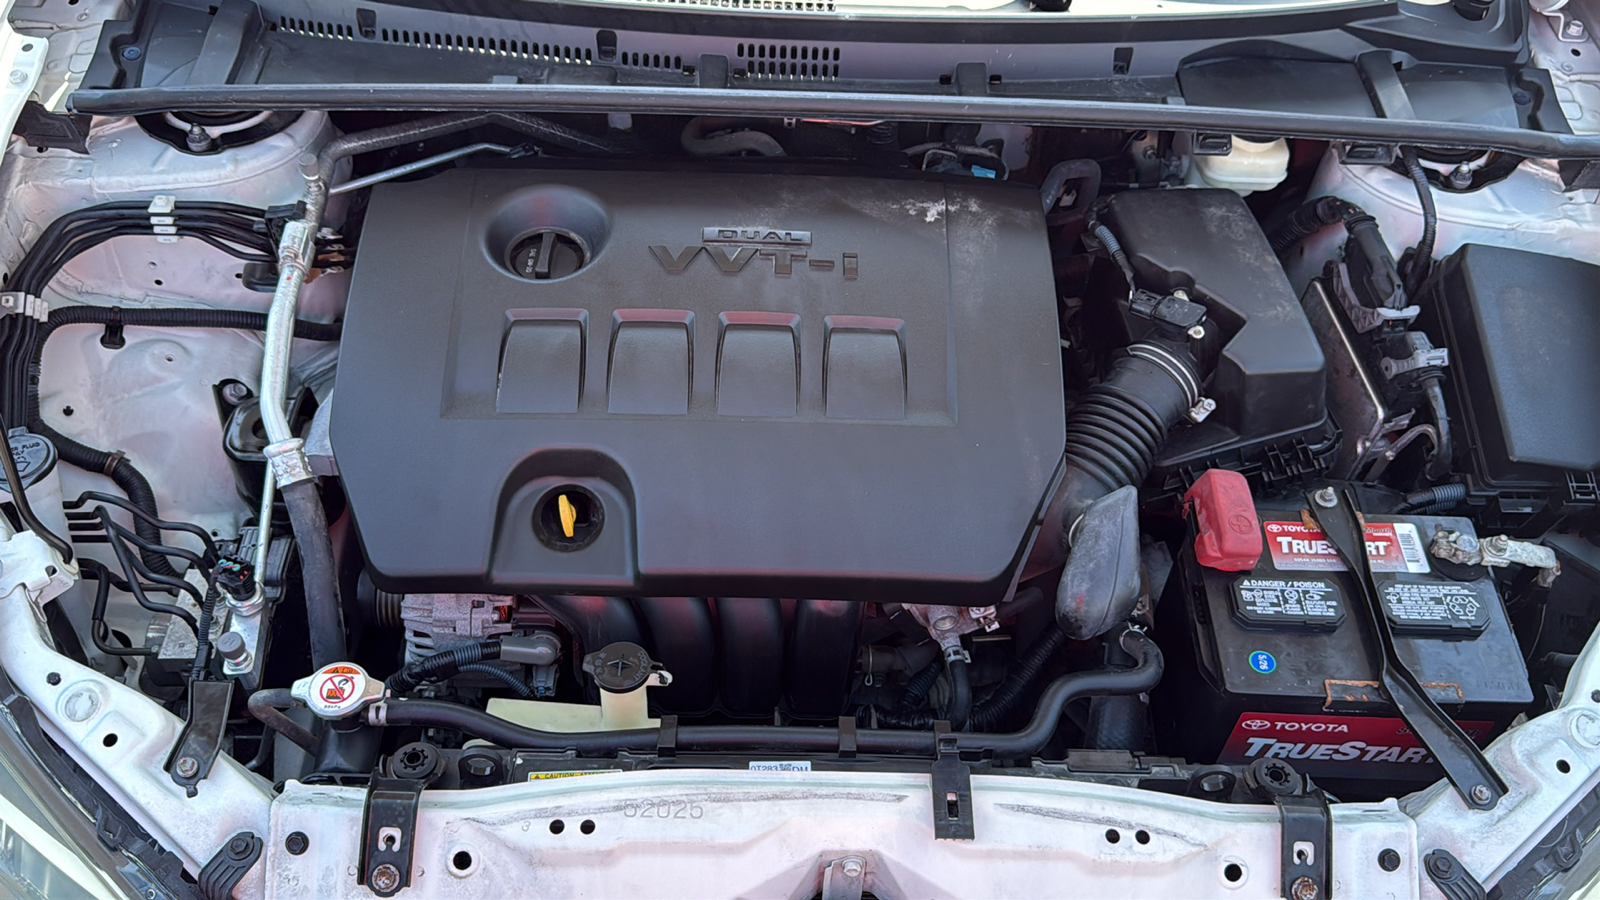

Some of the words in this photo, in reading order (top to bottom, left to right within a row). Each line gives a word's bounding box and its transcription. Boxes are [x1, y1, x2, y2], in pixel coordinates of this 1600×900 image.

[718, 229, 803, 241] DUAL
[22, 442, 40, 450] FLUID
[1251, 580, 1285, 588] DANGER
[1257, 654, 1269, 670] 5/26
[1274, 721, 1348, 733] TOYOTA
[1244, 738, 1434, 763] TRUESTAR
